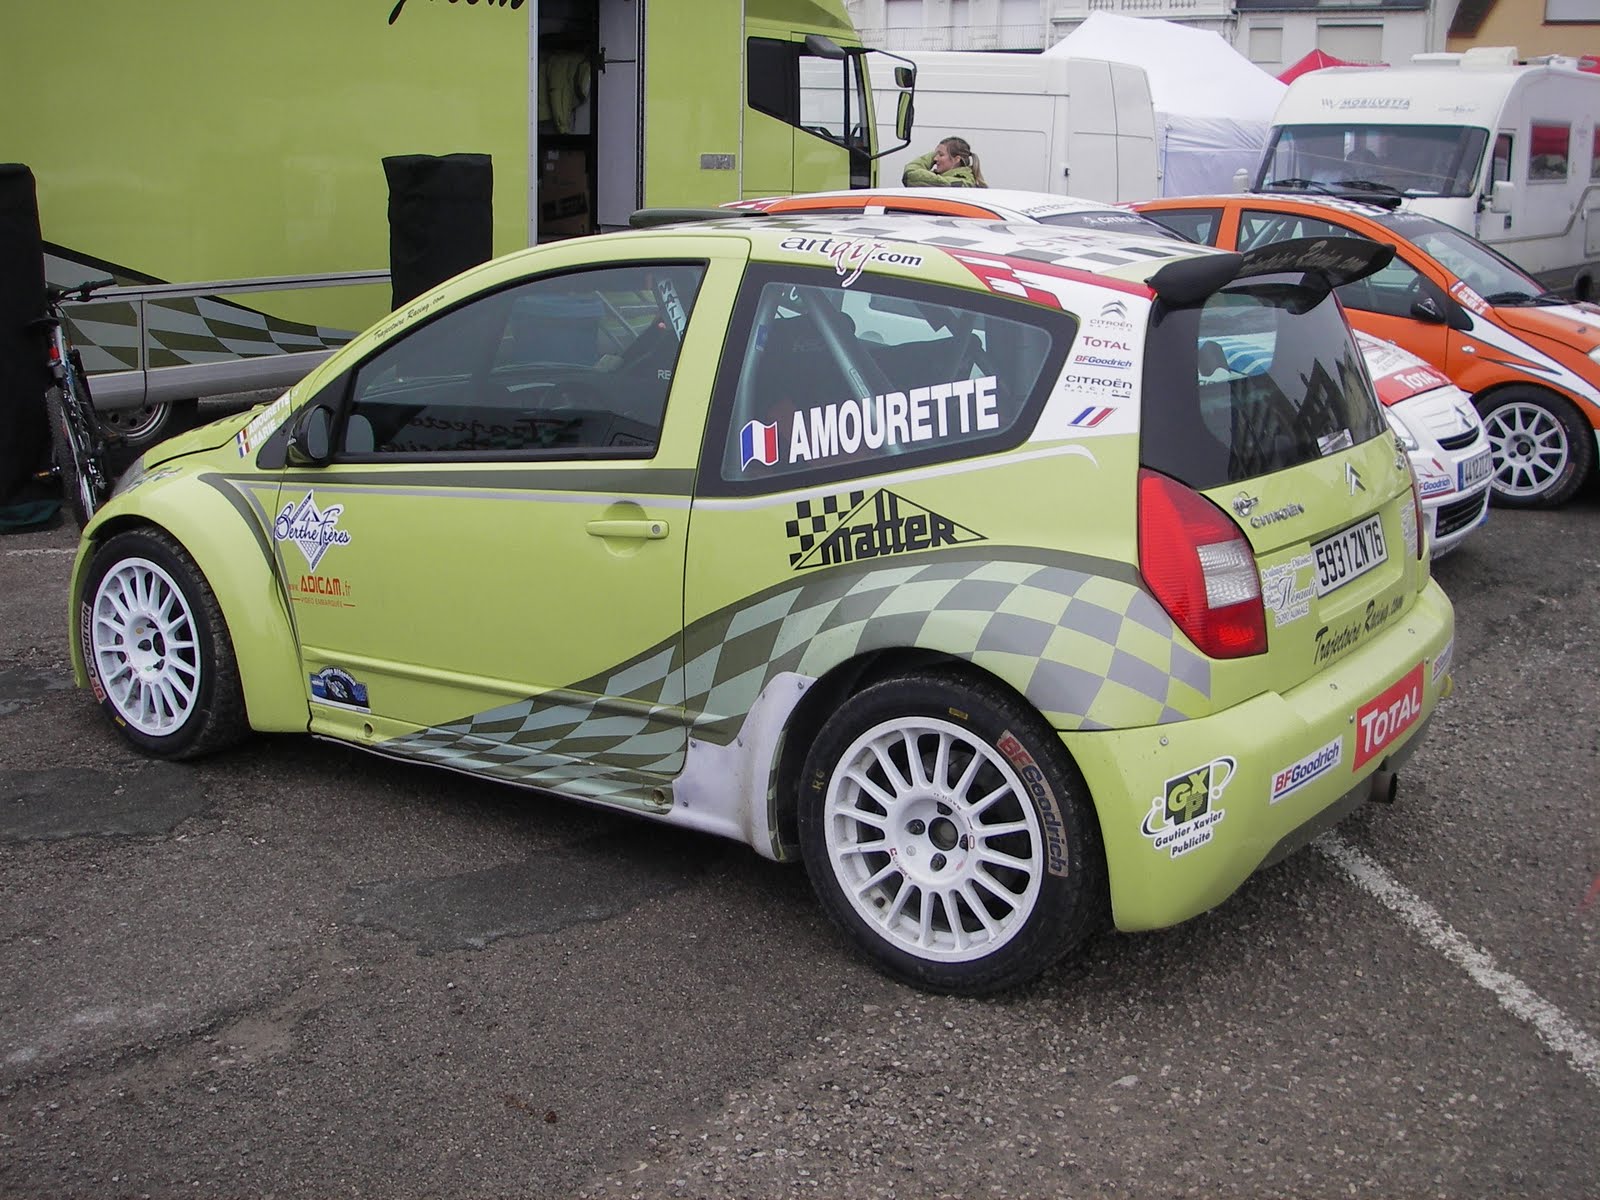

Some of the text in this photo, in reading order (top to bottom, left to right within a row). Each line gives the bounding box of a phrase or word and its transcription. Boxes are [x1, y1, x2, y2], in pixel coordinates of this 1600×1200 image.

[1074, 355, 1132, 368] BFGoodrich
[1082, 335, 1132, 351] TOTAL
[1393, 370, 1441, 390] TOTAL
[789, 375, 999, 464] AMOURETTE
[82, 602, 105, 700] BFGoodrich
[1361, 685, 1420, 753] TOTAL
[1274, 742, 1339, 793] BFGoodrich
[1000, 735, 1068, 874] BFGoodrich
[1155, 811, 1223, 848] Gautier Xavier
[1171, 830, 1211, 856] Publicité
